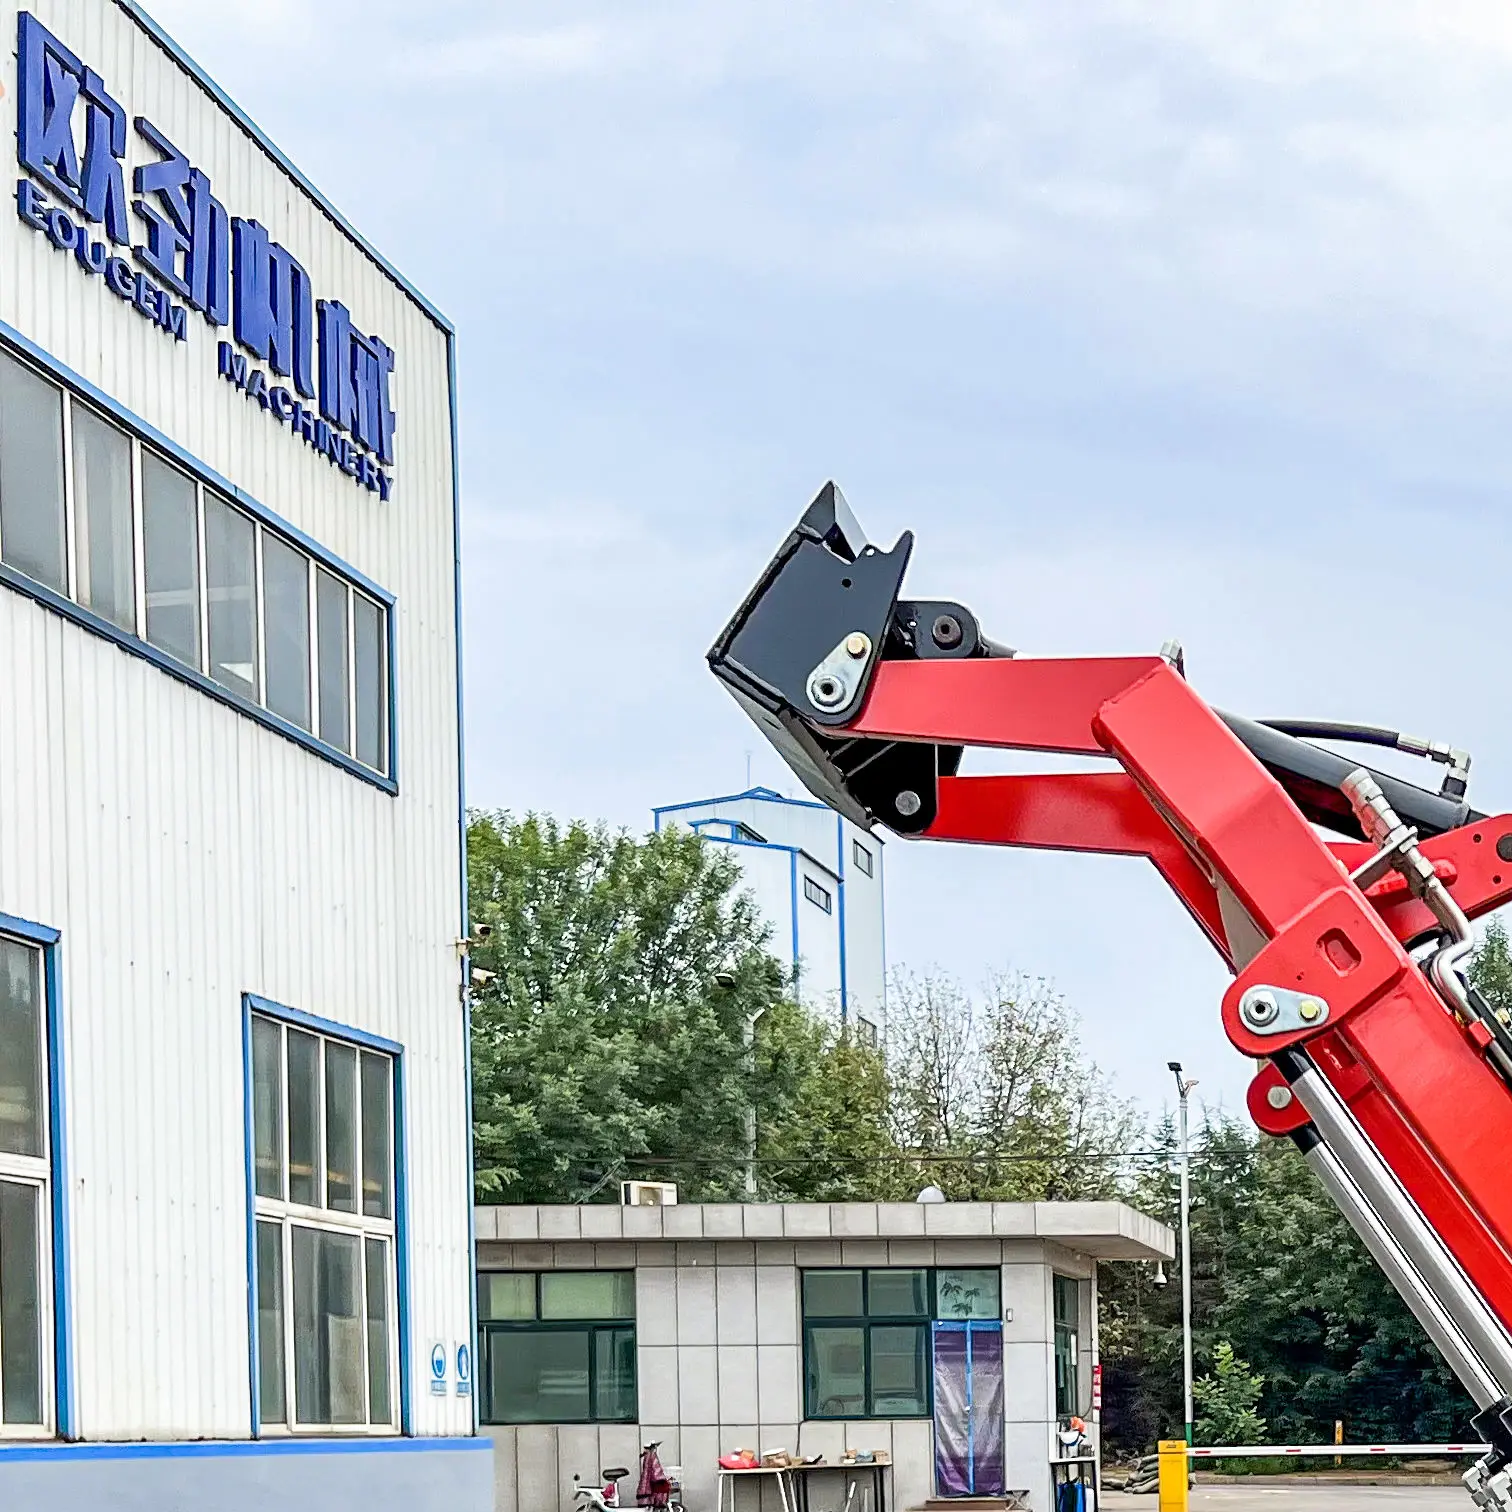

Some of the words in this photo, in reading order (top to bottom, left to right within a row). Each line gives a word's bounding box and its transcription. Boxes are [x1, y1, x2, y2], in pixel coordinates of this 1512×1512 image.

[17, 11, 395, 466] 欧劲机械
[17, 178, 187, 342] EOUGEM
[218, 341, 394, 502] MACHINERY
